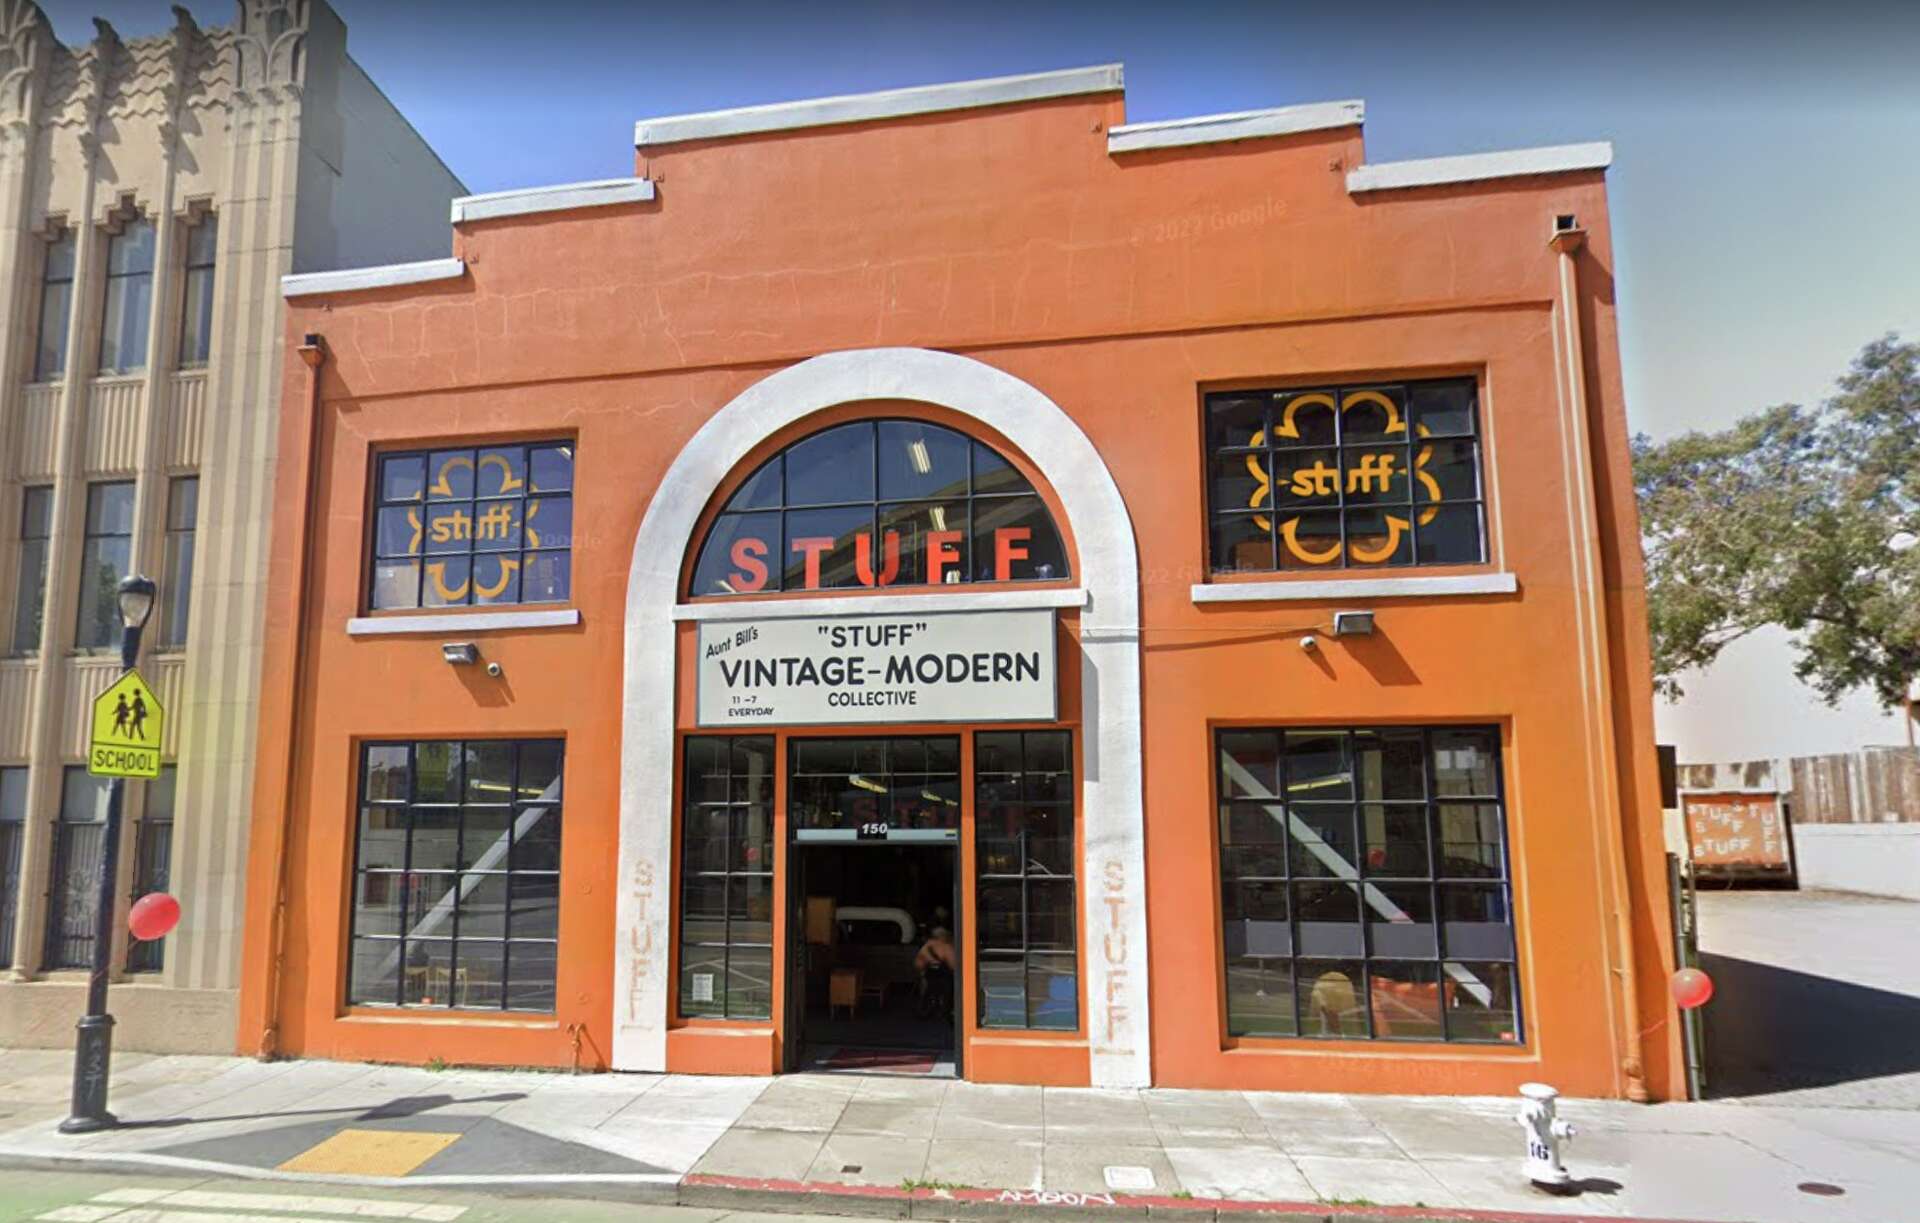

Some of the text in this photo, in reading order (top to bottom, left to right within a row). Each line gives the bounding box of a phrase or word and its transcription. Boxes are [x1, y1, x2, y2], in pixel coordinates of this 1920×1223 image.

[1291, 454, 1395, 496] stuff
[431, 504, 514, 543] stuff
[728, 527, 1032, 593] STUFF
[706, 625, 758, 659] Aunt Bill's
[818, 622, 927, 648] "STUFF"
[719, 652, 1039, 688] VINTAGE-MODERN
[728, 707, 774, 717] EVERYDAY
[828, 690, 917, 707] COLLECTIVE
[94, 750, 155, 771] SCHOOL
[861, 823, 888, 834] 150
[1693, 837, 1752, 857] STUFF
[1103, 860, 1128, 1043] STUFF
